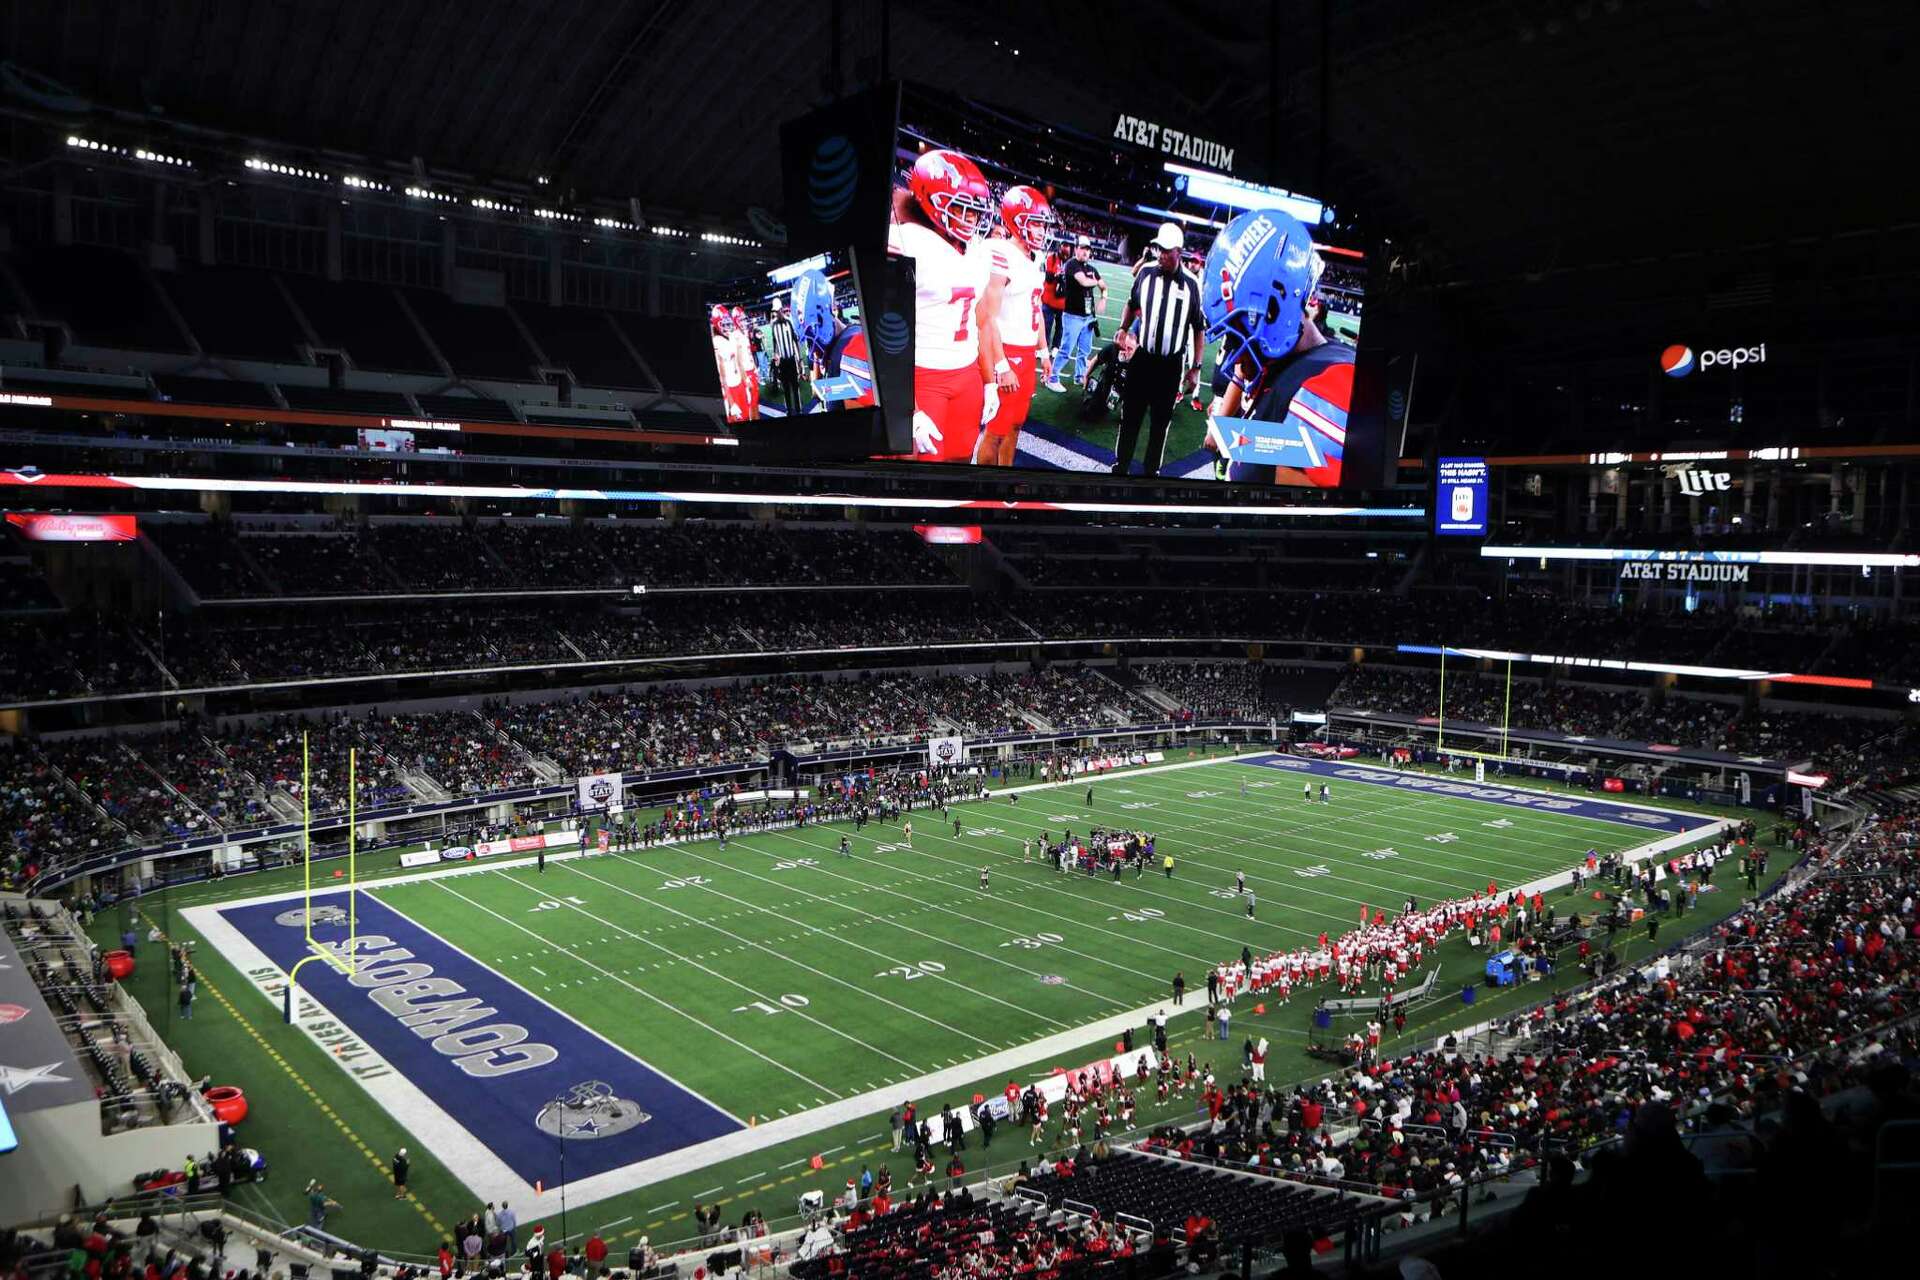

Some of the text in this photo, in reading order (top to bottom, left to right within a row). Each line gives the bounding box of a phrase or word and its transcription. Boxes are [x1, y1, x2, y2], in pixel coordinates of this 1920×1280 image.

[1113, 113, 1235, 172] AT&T STADIUM
[947, 287, 976, 341] 7
[1700, 343, 1766, 372] pepsi
[1675, 468, 1732, 497] Lite
[1620, 562, 1750, 582] AT&T STADIUM
[1333, 768, 1583, 810] COWBOYS
[538, 896, 588, 910] 10
[1122, 908, 1166, 922] 40
[1012, 932, 1064, 949] 30
[889, 960, 946, 981] 20
[299, 997, 326, 1019] AL
[306, 935, 559, 1078] COWBOYS
[748, 993, 810, 1016] 10
[307, 1020, 370, 1063] TAKES
